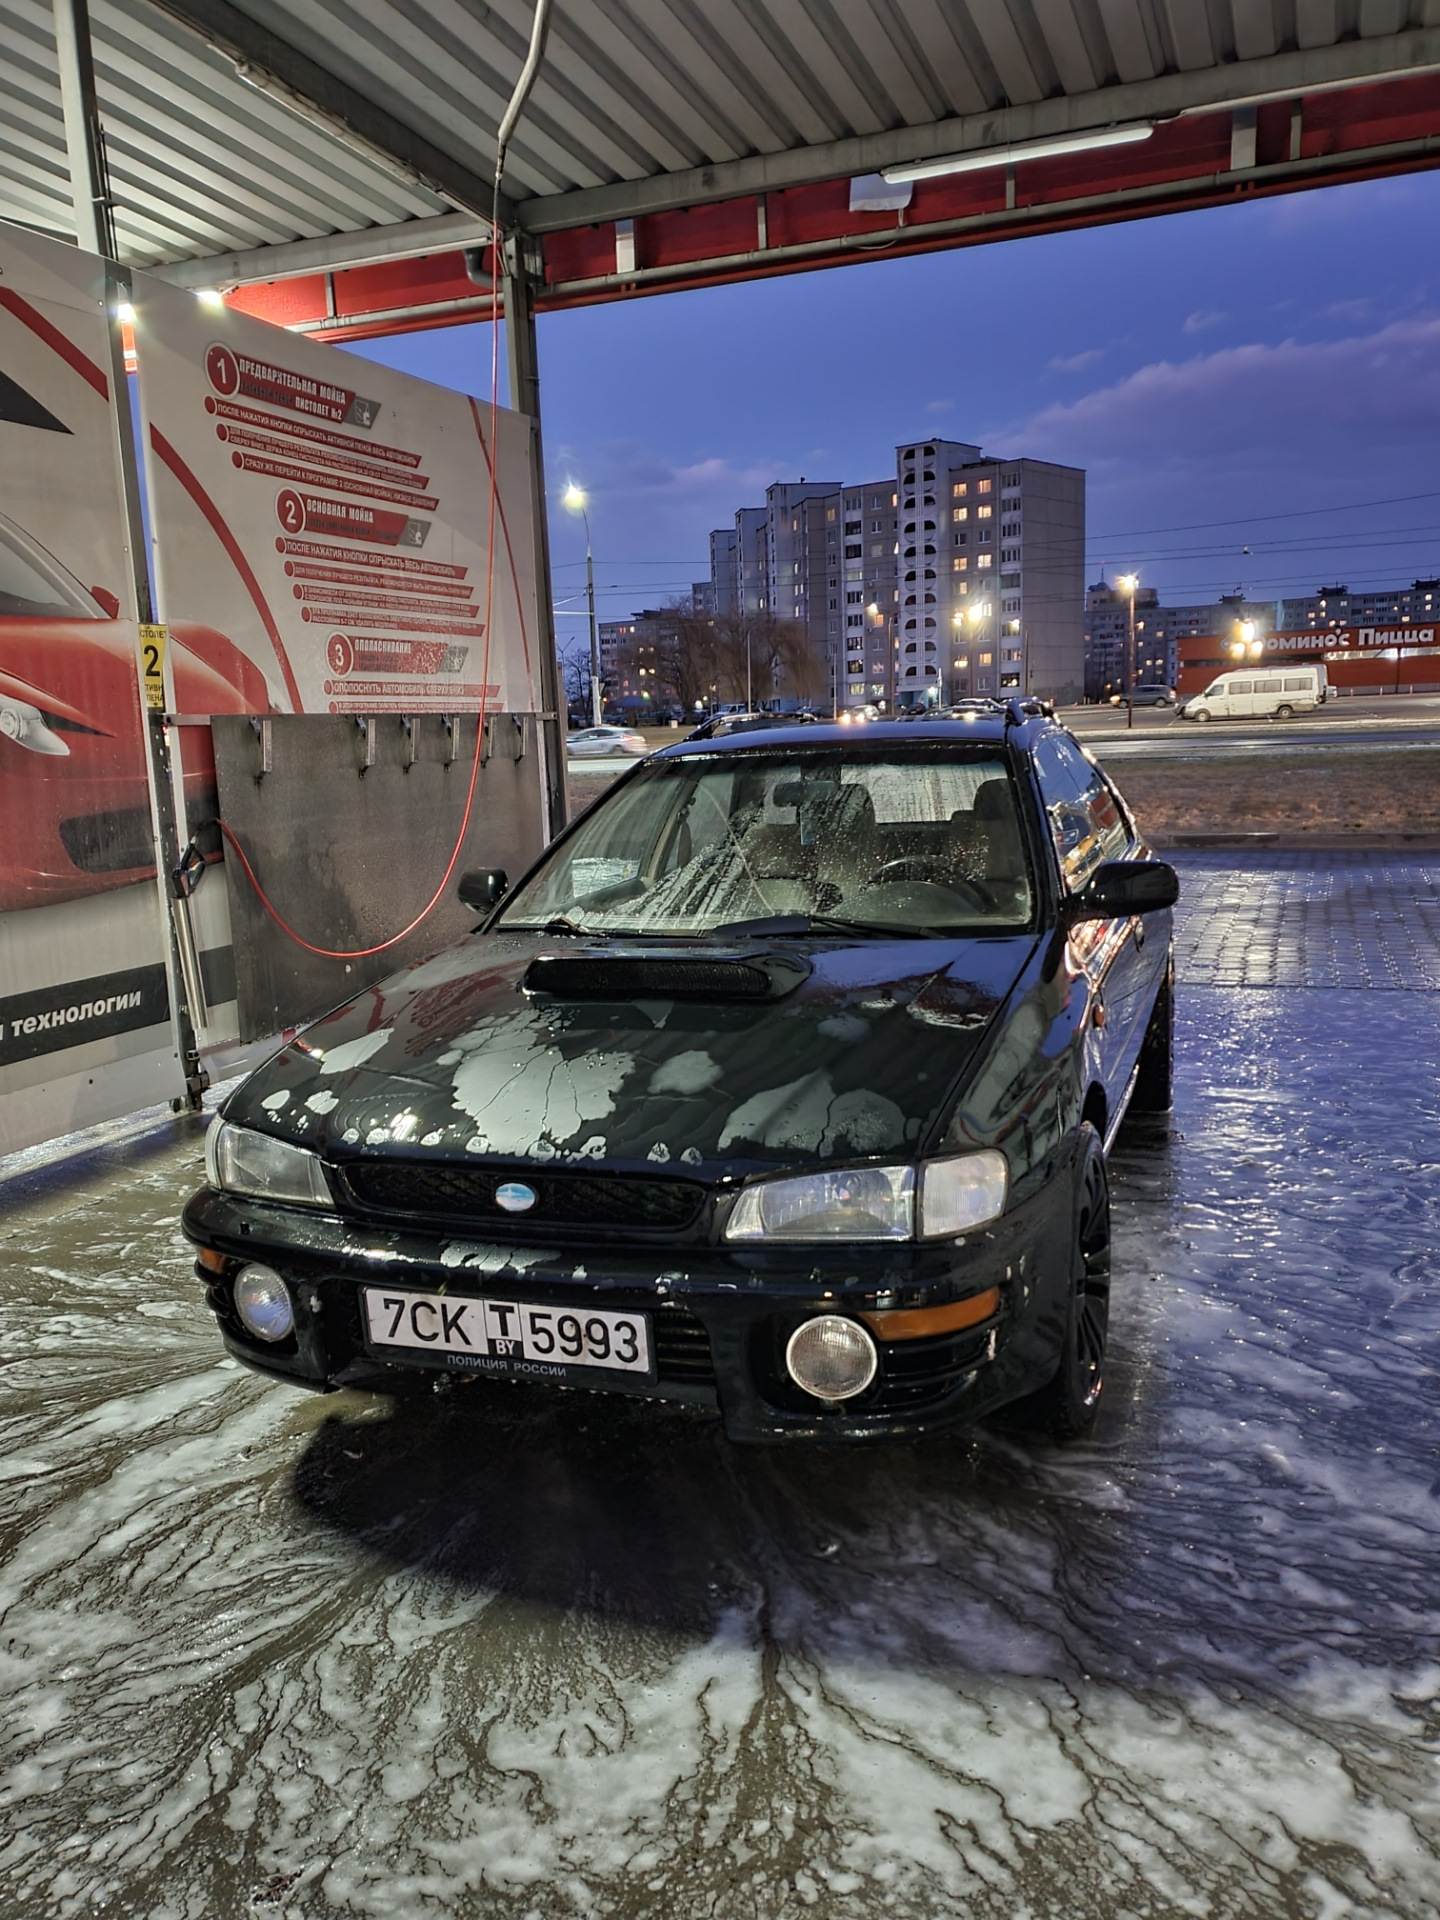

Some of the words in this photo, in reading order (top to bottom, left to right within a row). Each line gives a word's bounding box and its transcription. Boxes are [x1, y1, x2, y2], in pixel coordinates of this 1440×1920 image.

[217, 358, 226, 384] 1
[240, 358, 317, 395] ПРЕДВАРИТЕЛЬНАЯ
[319, 385, 346, 404] МОЙКА
[295, 396, 329, 416] ПИСТОЛЕТ
[218, 404, 239, 417] ПОСЛЕ
[240, 410, 269, 425] НАЖАТИЯ
[270, 418, 292, 431] КНОПКИ
[294, 425, 326, 441] ОПРЫСКАТЬ
[328, 434, 354, 448] АКТИВНОЙ
[245, 457, 263, 469] СРАЗУ
[264, 462, 274, 472] ЖЕ
[275, 464, 300, 478] ПЕРЕЙТИ
[306, 472, 338, 486] ПРОГРАММЕ
[285, 500, 297, 524] 2
[306, 498, 346, 518] ОСНОВНАЯ
[349, 507, 374, 523] МОЙКА
[287, 541, 310, 553] ПОСЛЕ
[311, 545, 342, 558] НАЖАТИЯ
[343, 550, 367, 562] КНОПКИ
[368, 555, 404, 568] ОПРЫСКАТЬ
[405, 561, 420, 571] ВЕСЬ
[354, 639, 411, 654] ОПОЛАСКИВАНИЕ
[1358, 628, 1434, 646] Пицца
[144, 645, 160, 676] 2
[335, 644, 344, 666] 3
[334, 683, 381, 693] ОПОЛОСНУТЬ
[382, 683, 425, 693] АВТОМОБИЛЬ
[11, 990, 142, 1037] технологии
[383, 1297, 472, 1346] 7CK
[489, 1303, 515, 1337] T
[529, 1311, 639, 1364] 5993
[496, 1339, 515, 1356] BY
[447, 1355, 508, 1371] ПОЛИЦИЯ
[513, 1362, 567, 1378] РОССИИ
